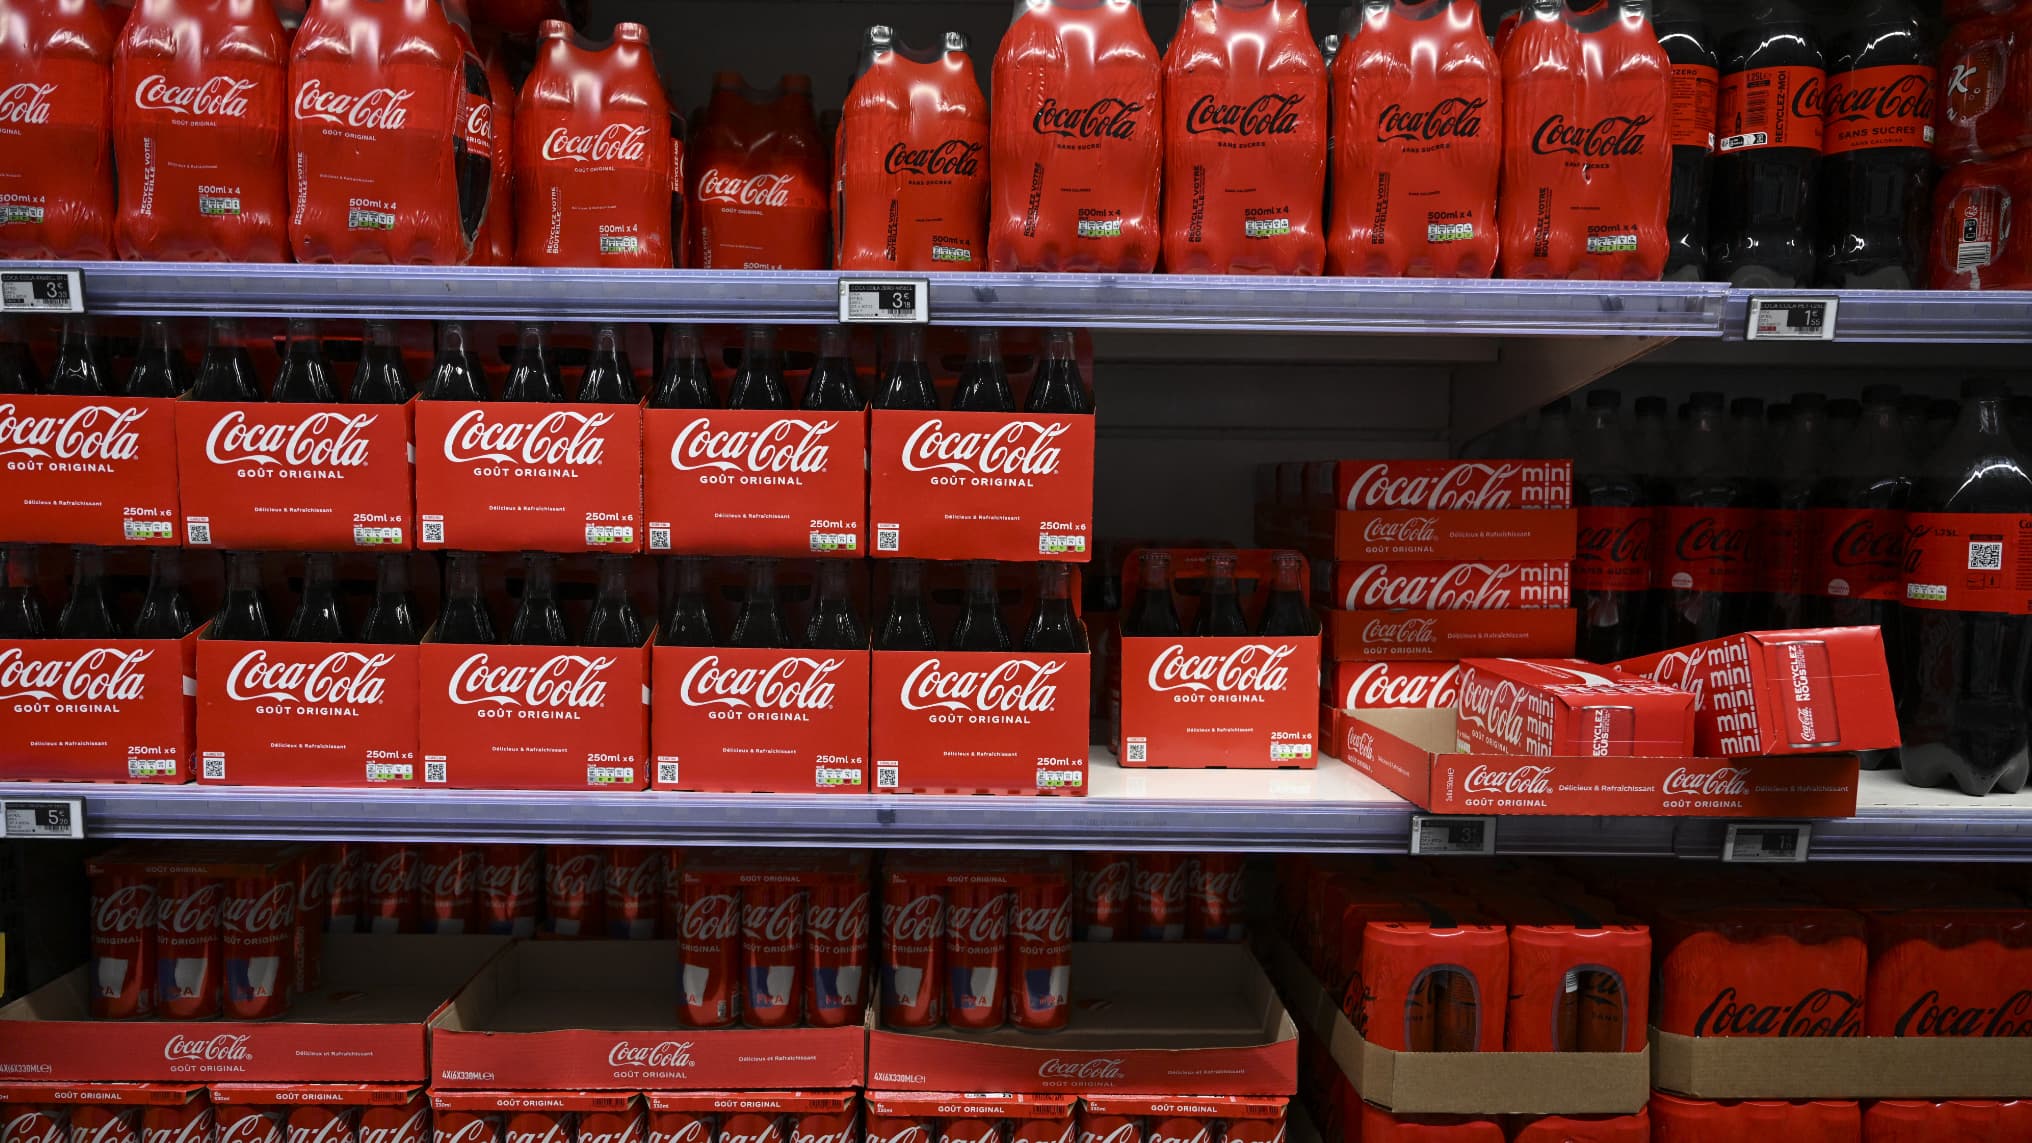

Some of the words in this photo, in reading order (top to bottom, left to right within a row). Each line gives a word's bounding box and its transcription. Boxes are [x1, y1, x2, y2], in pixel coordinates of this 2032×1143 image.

[136, 75, 257, 117] Coca-Cola
[295, 79, 414, 129] Coca-Cola
[1824, 75, 1936, 127] Coca-Cola
[1186, 94, 1304, 136] Coca-Cola
[1775, 71, 1787, 142] RECYCLEZ-MOI
[1033, 98, 1144, 139] Coca-Cola
[1377, 97, 1487, 142] Coca-Cola
[323, 128, 343, 137] GOÛT
[345, 131, 377, 142] ORIGINAL
[542, 124, 650, 161] Coca-Cola
[1532, 114, 1652, 157] Coca-Cola
[1838, 129, 1868, 140] SANS
[1872, 126, 1915, 137] SUCRES
[885, 139, 983, 177] Coca-Cola
[199, 185, 227, 194] 500ml
[699, 169, 793, 206] Coca-Cola
[1193, 165, 1201, 194] VOTRE
[1078, 207, 1107, 219] 500ml
[1188, 195, 1200, 242] RECYCLEZ
[1194, 194, 1205, 242] BOUTEILLE
[1428, 211, 1458, 220] 500ml
[1588, 223, 1620, 235] 500ml
[932, 235, 959, 246] 500ml
[206, 411, 378, 466] Coca-Cola
[444, 410, 614, 464] Coca-Cola
[671, 418, 838, 472] Coca-Cola
[902, 419, 1071, 474] Coca-Cola
[8, 459, 44, 471] GOÛT
[49, 462, 115, 473] ORIGINAL
[238, 467, 274, 478] GOÛT
[279, 469, 345, 479] ORIGINAL
[474, 465, 510, 477] GOÛT
[515, 468, 579, 478] ORIGINAL
[1521, 463, 1570, 483] mini
[700, 473, 735, 485] GOÛT
[740, 475, 803, 486] ORIGINAL
[931, 475, 967, 486] GOÛT
[971, 477, 1034, 487] ORIGINAL
[1347, 464, 1523, 510] Coca-Cola
[1522, 483, 1570, 504] mini
[124, 506, 158, 517] 250ml
[354, 513, 388, 522] 250ml
[586, 512, 620, 521] 250ml
[810, 519, 844, 529] 250ml
[1040, 521, 1073, 530] 250ml
[1364, 518, 1436, 541] Coca-Cola
[1366, 545, 1389, 553] GOÛT
[1521, 563, 1568, 582] mini
[1346, 564, 1520, 608] Coca-Cola
[1521, 583, 1568, 601] mini
[1362, 619, 1436, 643] Coca-Cola
[1364, 647, 1388, 655] GOÛT
[1391, 647, 1433, 655] ORIGINAL
[1707, 637, 1749, 666] mini
[227, 650, 395, 704] Coca-Cola
[1149, 645, 1296, 691] Coca-Cola
[1710, 663, 1751, 688] mini
[1790, 645, 1803, 702] RECYCLEZ
[449, 653, 616, 707] Coca-Cola
[681, 656, 844, 708] Coca-Cola
[901, 659, 1065, 711] Coca-Cola
[1802, 668, 1811, 701] NOUS
[1174, 692, 1206, 703] GOÛT
[1210, 694, 1265, 703] ORIGINAL
[1459, 667, 1529, 744] Coca-Cola
[1529, 694, 1555, 718] mini
[1713, 684, 1754, 710] mini
[14, 702, 51, 713] GOÛT
[56, 704, 121, 713] ORIGINAL
[256, 704, 292, 715] GOÛT
[297, 706, 360, 717] ORIGINAL
[478, 707, 513, 718] GOÛT
[518, 710, 581, 720] ORIGINAL
[709, 709, 743, 720] GOÛT
[748, 711, 810, 722] ORIGINAL
[929, 713, 964, 724] GOÛT
[969, 715, 1031, 724] ORIGINAL
[1527, 716, 1553, 740] mini
[1717, 707, 1757, 732] mini
[1800, 706, 1811, 742] Coca-Cola
[1592, 709, 1603, 756] ECYCLEZ
[1721, 729, 1761, 755] mini
[128, 745, 162, 755] 250ml
[1347, 726, 1374, 760] Coca-Cola
[1526, 738, 1552, 756] mini
[1600, 733, 1608, 757] OUS
[367, 750, 400, 759] 250ml
[588, 753, 621, 762] 250ml
[816, 754, 849, 764] 250ml
[1464, 765, 1554, 793] Coca-Cola
[1559, 784, 1593, 792] Délicieux
[1601, 785, 1655, 793] Rafraîchissant
[1663, 767, 1747, 794] Coca-Cola
[1465, 797, 1495, 807] GOÛT
[1498, 799, 1548, 807] ORIGINAL
[1663, 799, 1692, 808] GOÛT
[1695, 800, 1742, 808] ORIGINAL
[763, 875, 801, 883] ORIGINAL
[165, 1035, 252, 1060] Coca-Cola
[609, 1042, 695, 1066] Coca-Cola
[171, 1063, 197, 1072] GOÛT
[614, 1070, 640, 1078] GOÛT
[643, 1071, 688, 1079] ORIGINAL
[1039, 1059, 1124, 1078] Coca-Cola
[55, 1090, 79, 1099] GOÛT
[81, 1092, 122, 1100] ORIGINAL
[276, 1091, 300, 1100] GOÛT
[302, 1093, 344, 1101] ORIGINAL
[497, 1098, 521, 1107] GOÛT
[523, 1099, 564, 1107] ORIGINAL
[715, 1099, 738, 1108] GOÛT
[938, 1104, 962, 1113] GOÛT
[1151, 1103, 1175, 1112] GOÛT
[1177, 1105, 1218, 1113] ORIGINAL
